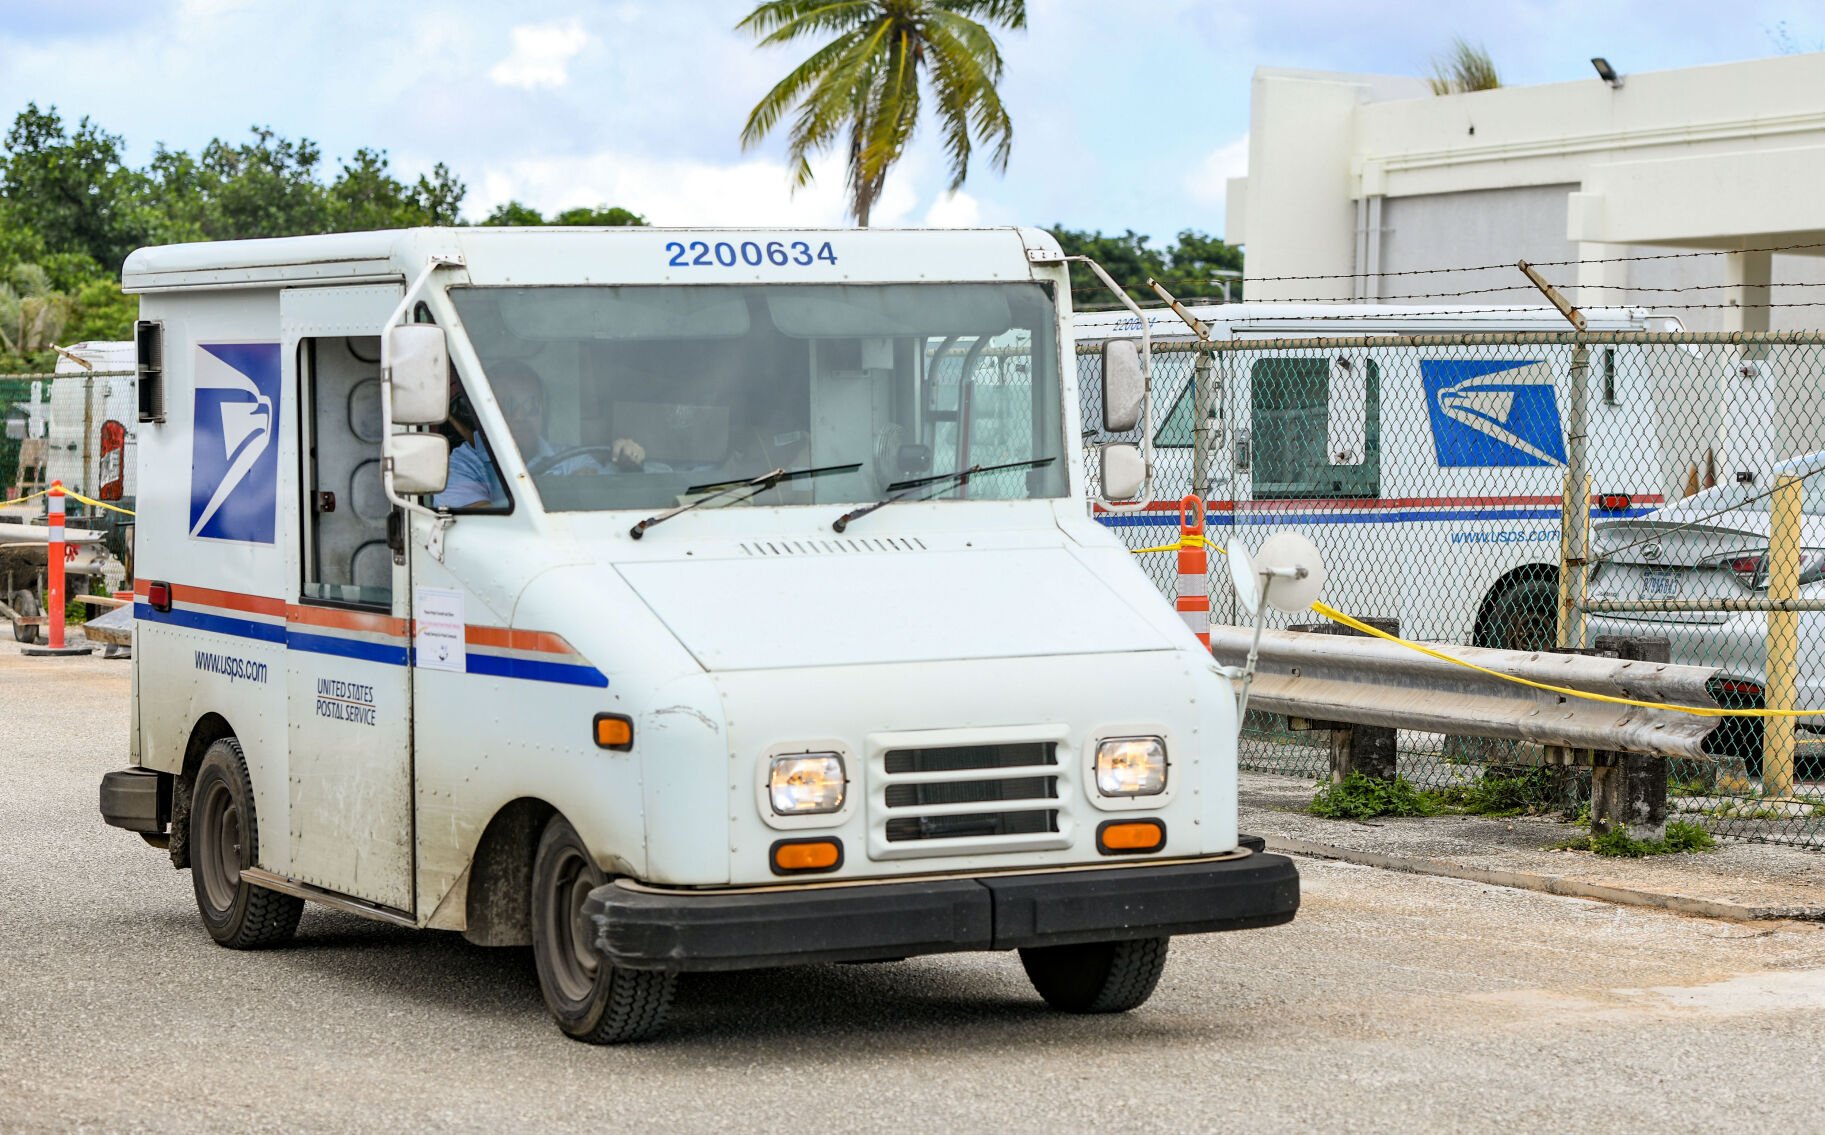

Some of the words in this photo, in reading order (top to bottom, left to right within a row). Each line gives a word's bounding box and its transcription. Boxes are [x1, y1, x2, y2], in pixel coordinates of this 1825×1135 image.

[665, 241, 838, 267] 2200634
[1451, 529, 1561, 545] www.usps.com
[194, 650, 268, 684] www.usps.com
[317, 678, 346, 698] UNITED
[346, 683, 374, 703] STATES
[316, 699, 344, 720] POSTAL
[345, 704, 376, 726] SERVICE
